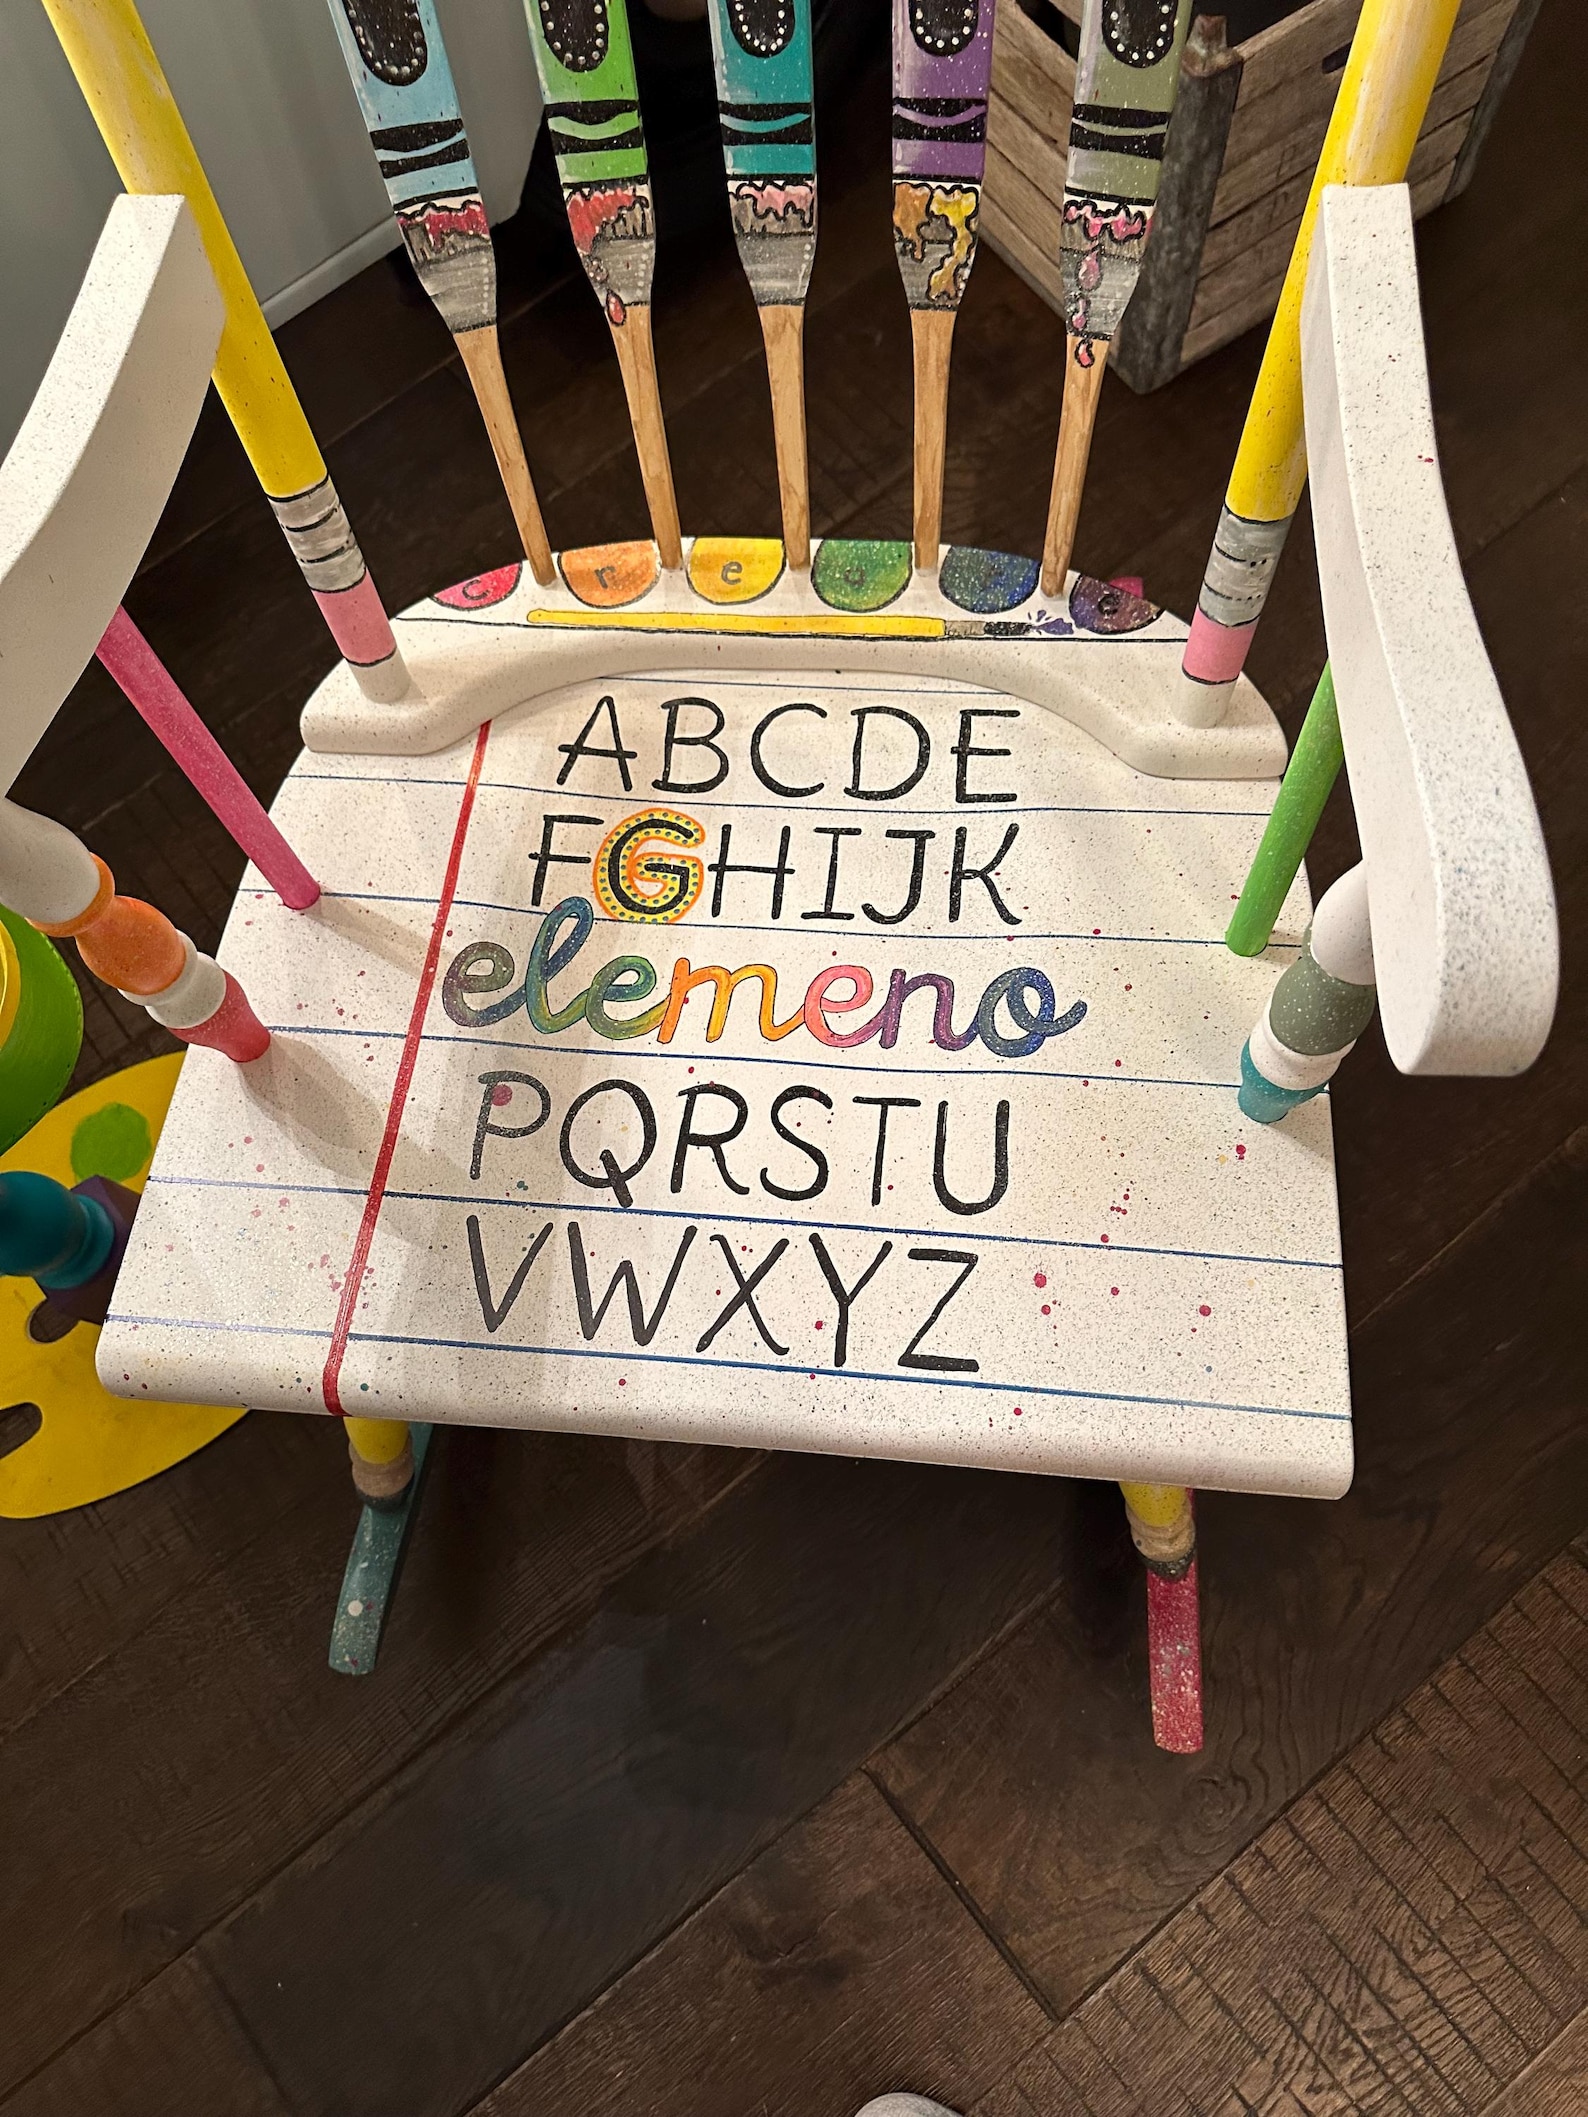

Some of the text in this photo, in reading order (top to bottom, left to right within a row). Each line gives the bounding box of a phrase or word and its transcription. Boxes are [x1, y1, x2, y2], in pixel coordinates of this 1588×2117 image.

[556, 694, 1022, 804] ABCDE
[527, 808, 1023, 926] FGHIJK
[442, 896, 1087, 1058] elemeno
[469, 1070, 1010, 1216] PQRSTU
[466, 1214, 980, 1372] VWXYZ
